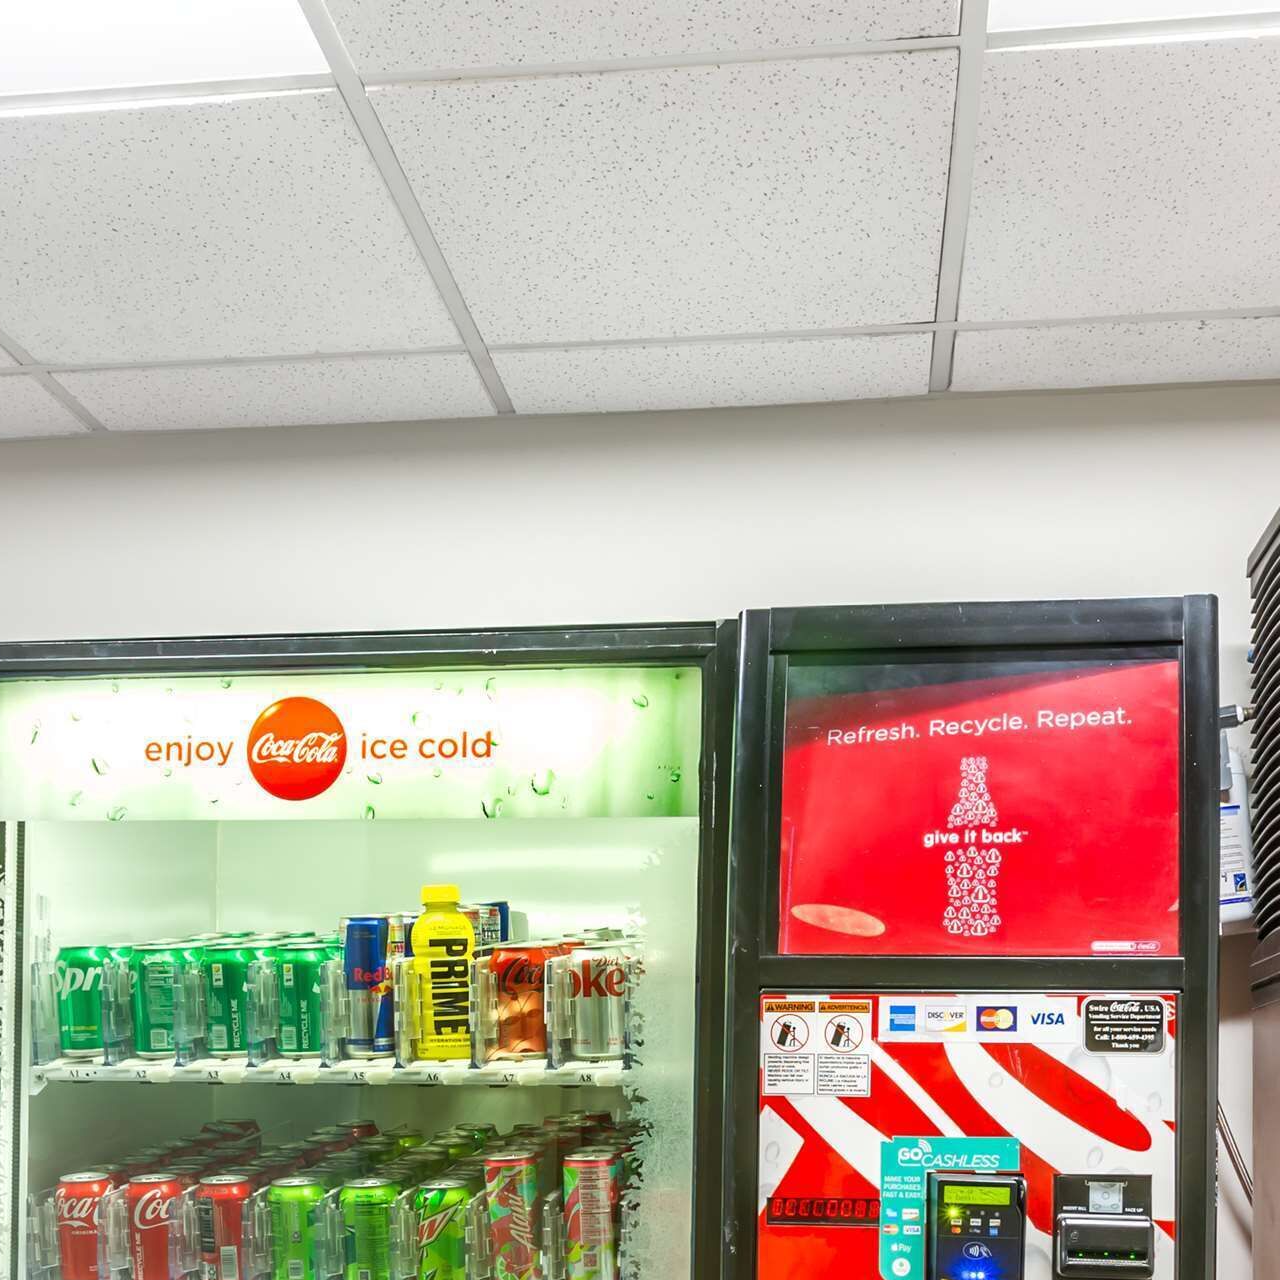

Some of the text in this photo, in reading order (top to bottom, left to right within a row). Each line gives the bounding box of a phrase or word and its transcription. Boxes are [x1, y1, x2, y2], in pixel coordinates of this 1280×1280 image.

[827, 706, 1133, 746] Refresh. Recycle. Repeat.
[145, 731, 493, 766] enjoy Coca-Cola ice cold
[924, 831, 959, 848] give
[964, 829, 978, 844] it
[354, 967, 382, 983] Red
[428, 938, 470, 1036] PRIME
[1088, 1004, 1160, 1012] Swire USA
[1031, 1012, 1065, 1026] VISA
[136, 1070, 147, 1079] A2
[208, 1070, 219, 1080] A3
[279, 1072, 290, 1080] A4
[426, 1073, 438, 1082] A6
[502, 1074, 514, 1082] A7
[579, 1074, 592, 1082] A8
[900, 1148, 1000, 1168] GO CASHLESS
[134, 1190, 176, 1230] Coc
[897, 1243, 912, 1253] Pay
